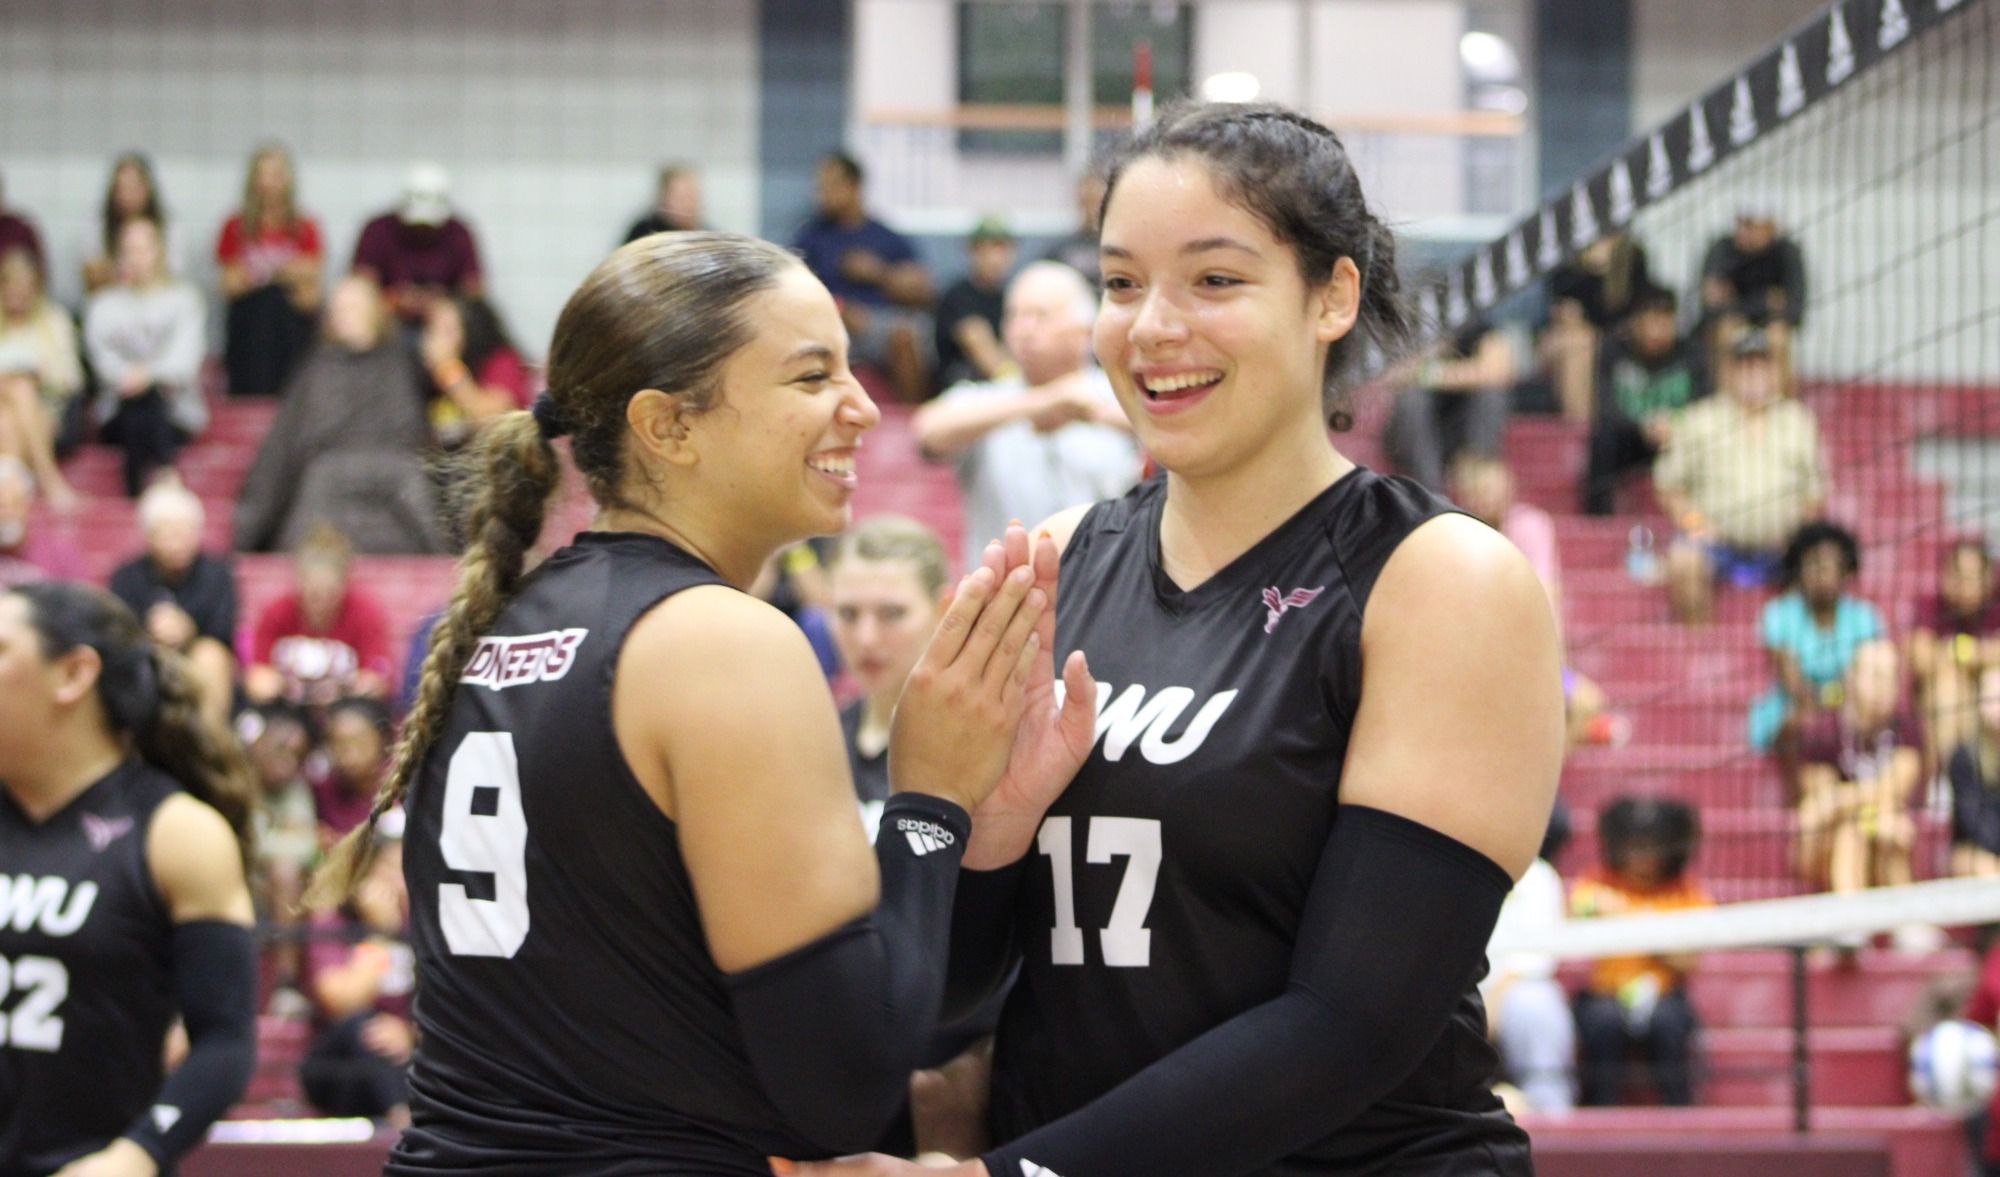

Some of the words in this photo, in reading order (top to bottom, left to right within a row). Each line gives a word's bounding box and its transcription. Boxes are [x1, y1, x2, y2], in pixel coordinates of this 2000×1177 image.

[459, 628, 589, 691] ONEERS
[1053, 679, 1239, 765] WU
[438, 731, 530, 960] 9
[897, 818, 955, 845] adidas
[0, 873, 99, 937] WU
[1037, 816, 1163, 967] 17
[0, 953, 70, 1052] 2
